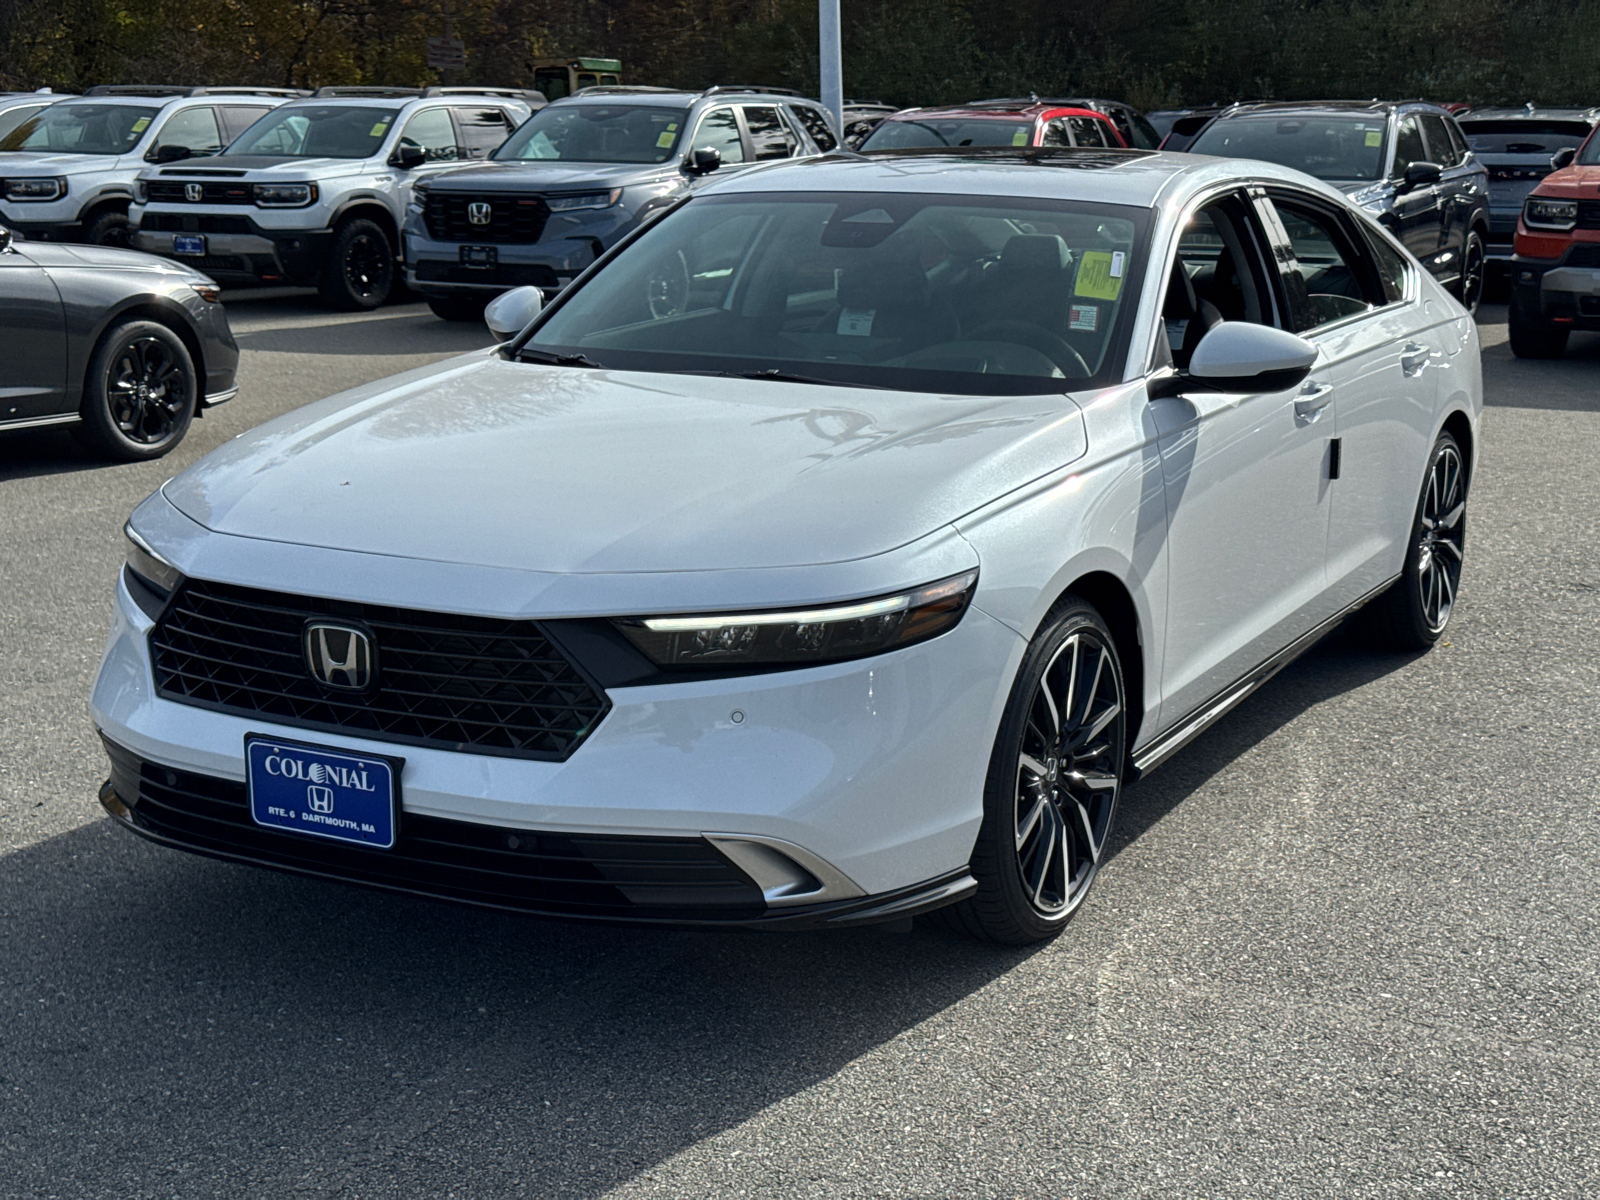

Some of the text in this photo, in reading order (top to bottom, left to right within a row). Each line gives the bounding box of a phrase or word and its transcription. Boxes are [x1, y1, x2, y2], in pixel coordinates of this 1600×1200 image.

[265, 755, 375, 792] COLONIAL
[268, 806, 375, 833] RTE. 6 DARTMOUTH, MA
